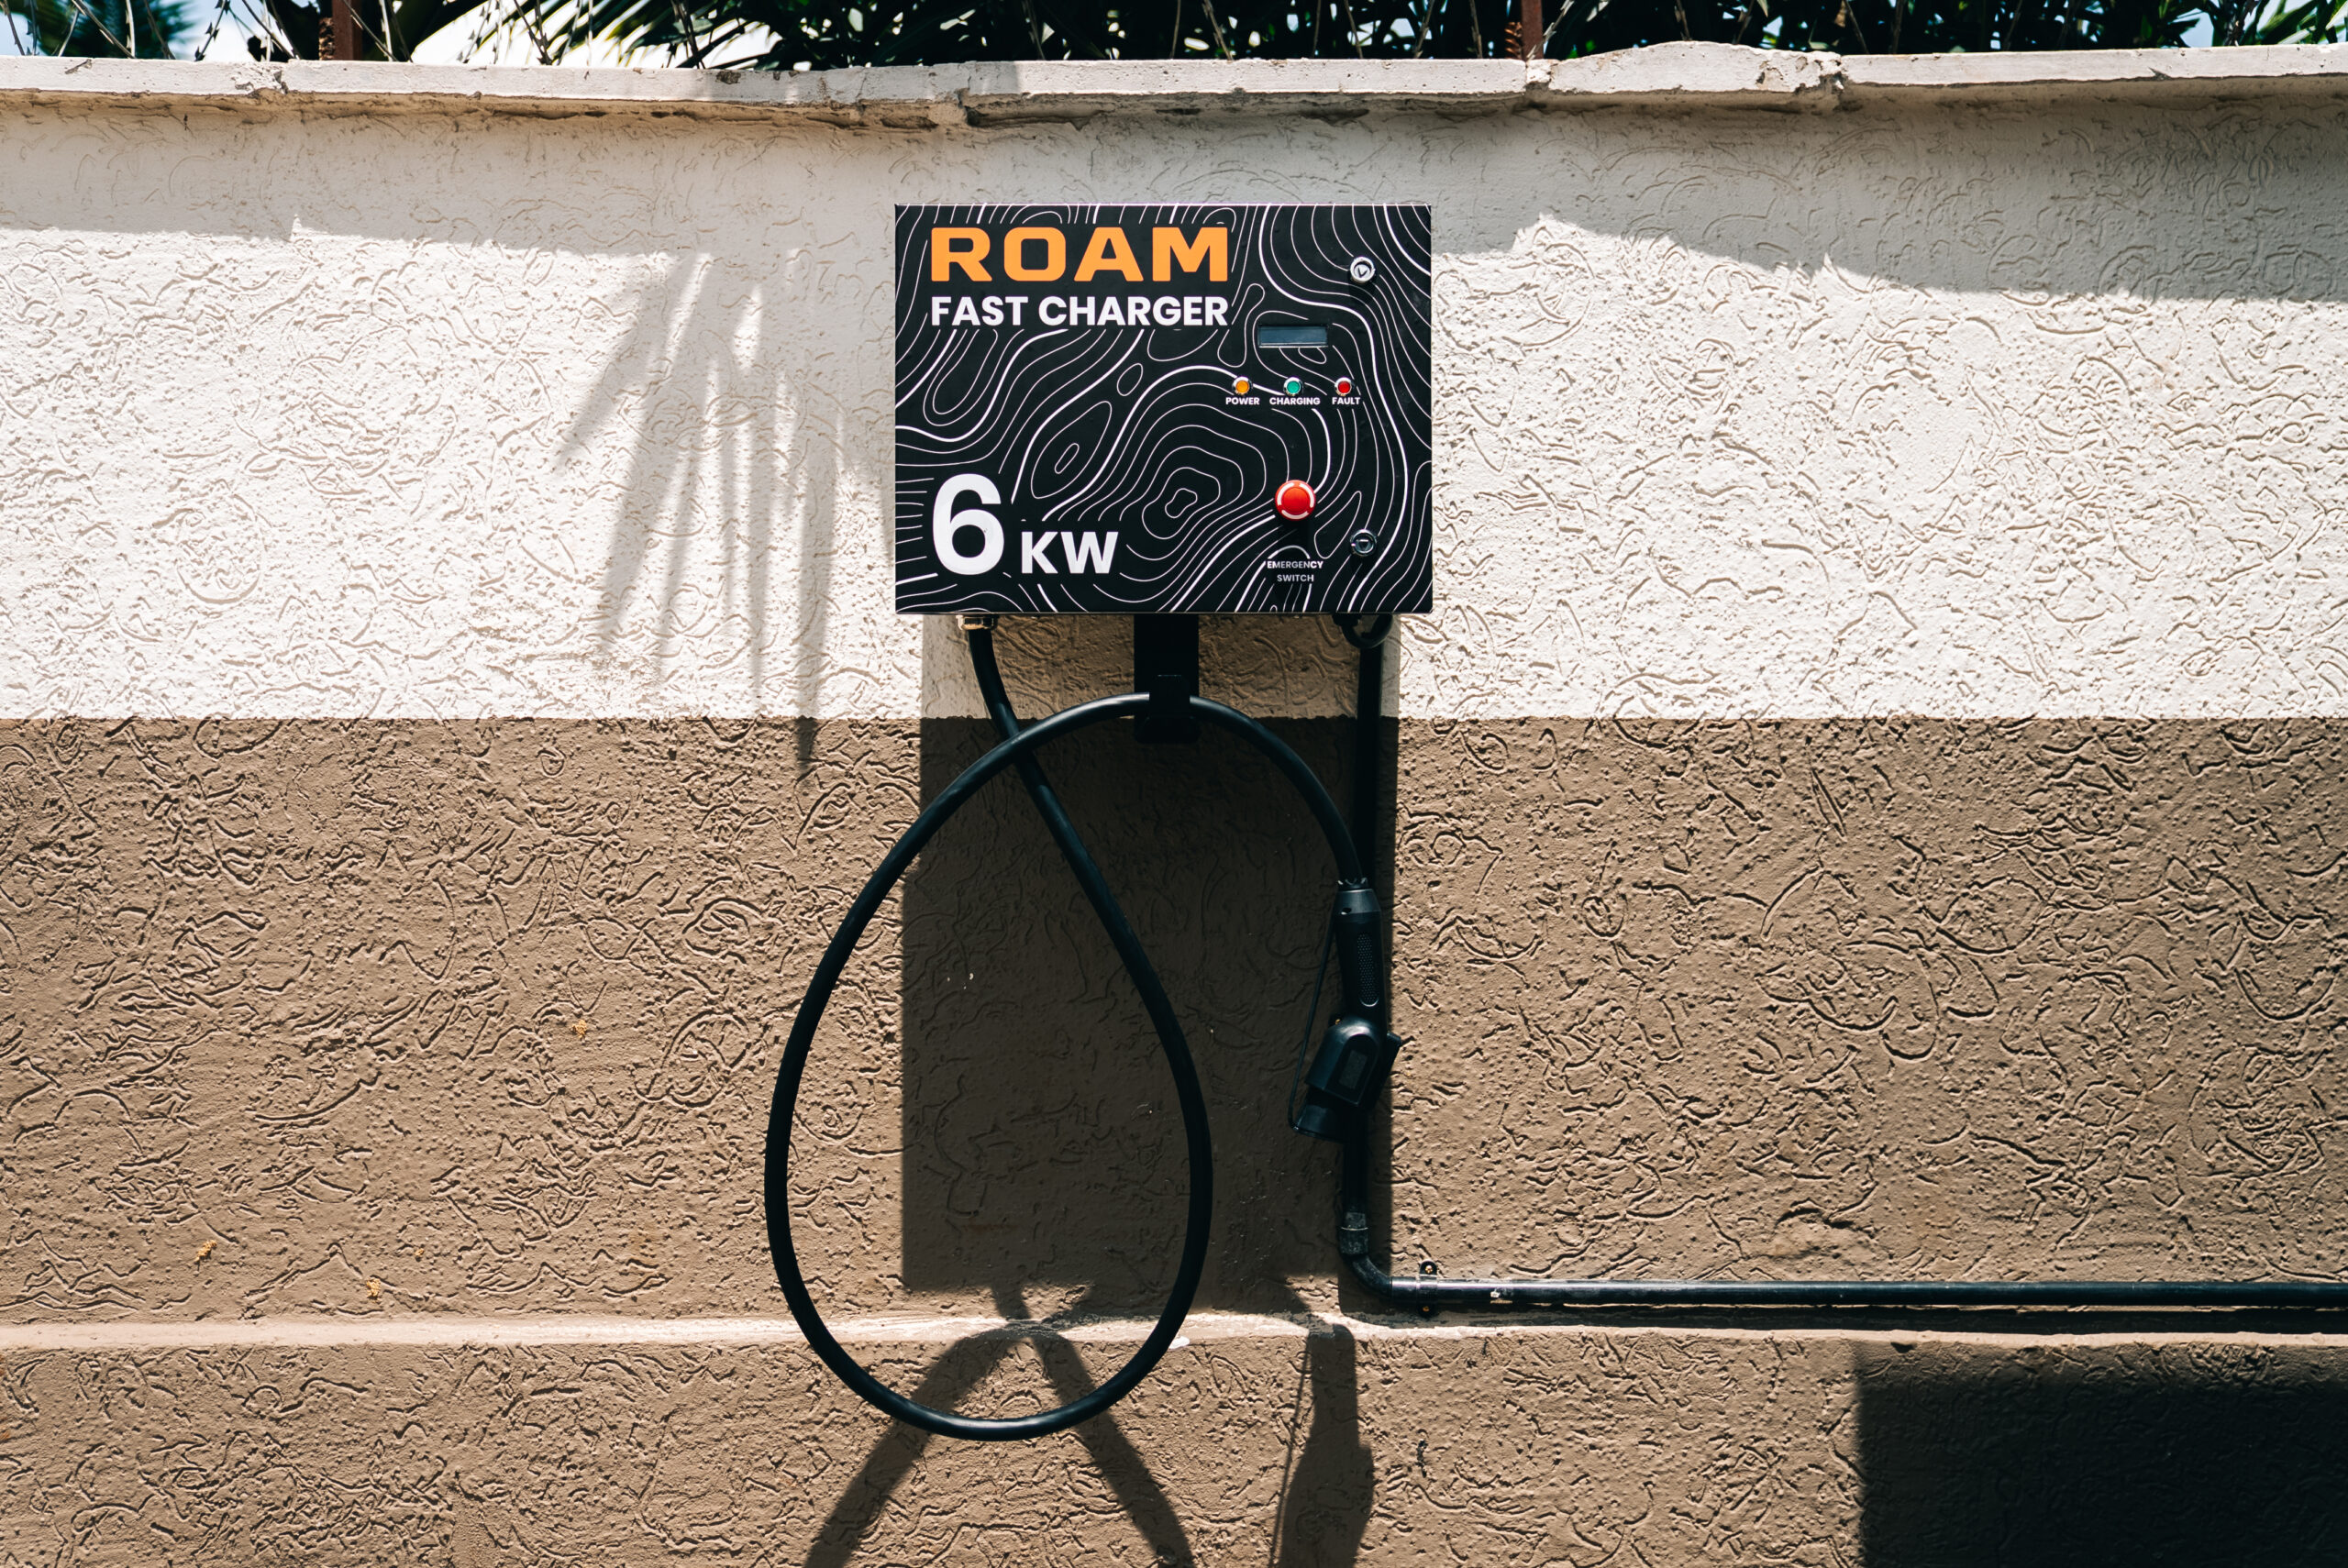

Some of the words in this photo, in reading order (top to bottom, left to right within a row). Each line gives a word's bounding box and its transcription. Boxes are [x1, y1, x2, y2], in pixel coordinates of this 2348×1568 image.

[930, 226, 1228, 282] ROAM
[931, 295, 1028, 326] FAST
[1037, 295, 1228, 327] CHARGER
[1225, 396, 1260, 405] POWER
[1268, 396, 1321, 405] CHARGING
[1332, 396, 1360, 405] FAULT
[932, 472, 1004, 576] 6
[1021, 531, 1118, 574] KW
[1267, 560, 1324, 569] EMERGENCY
[1277, 574, 1314, 582] SWITCH
